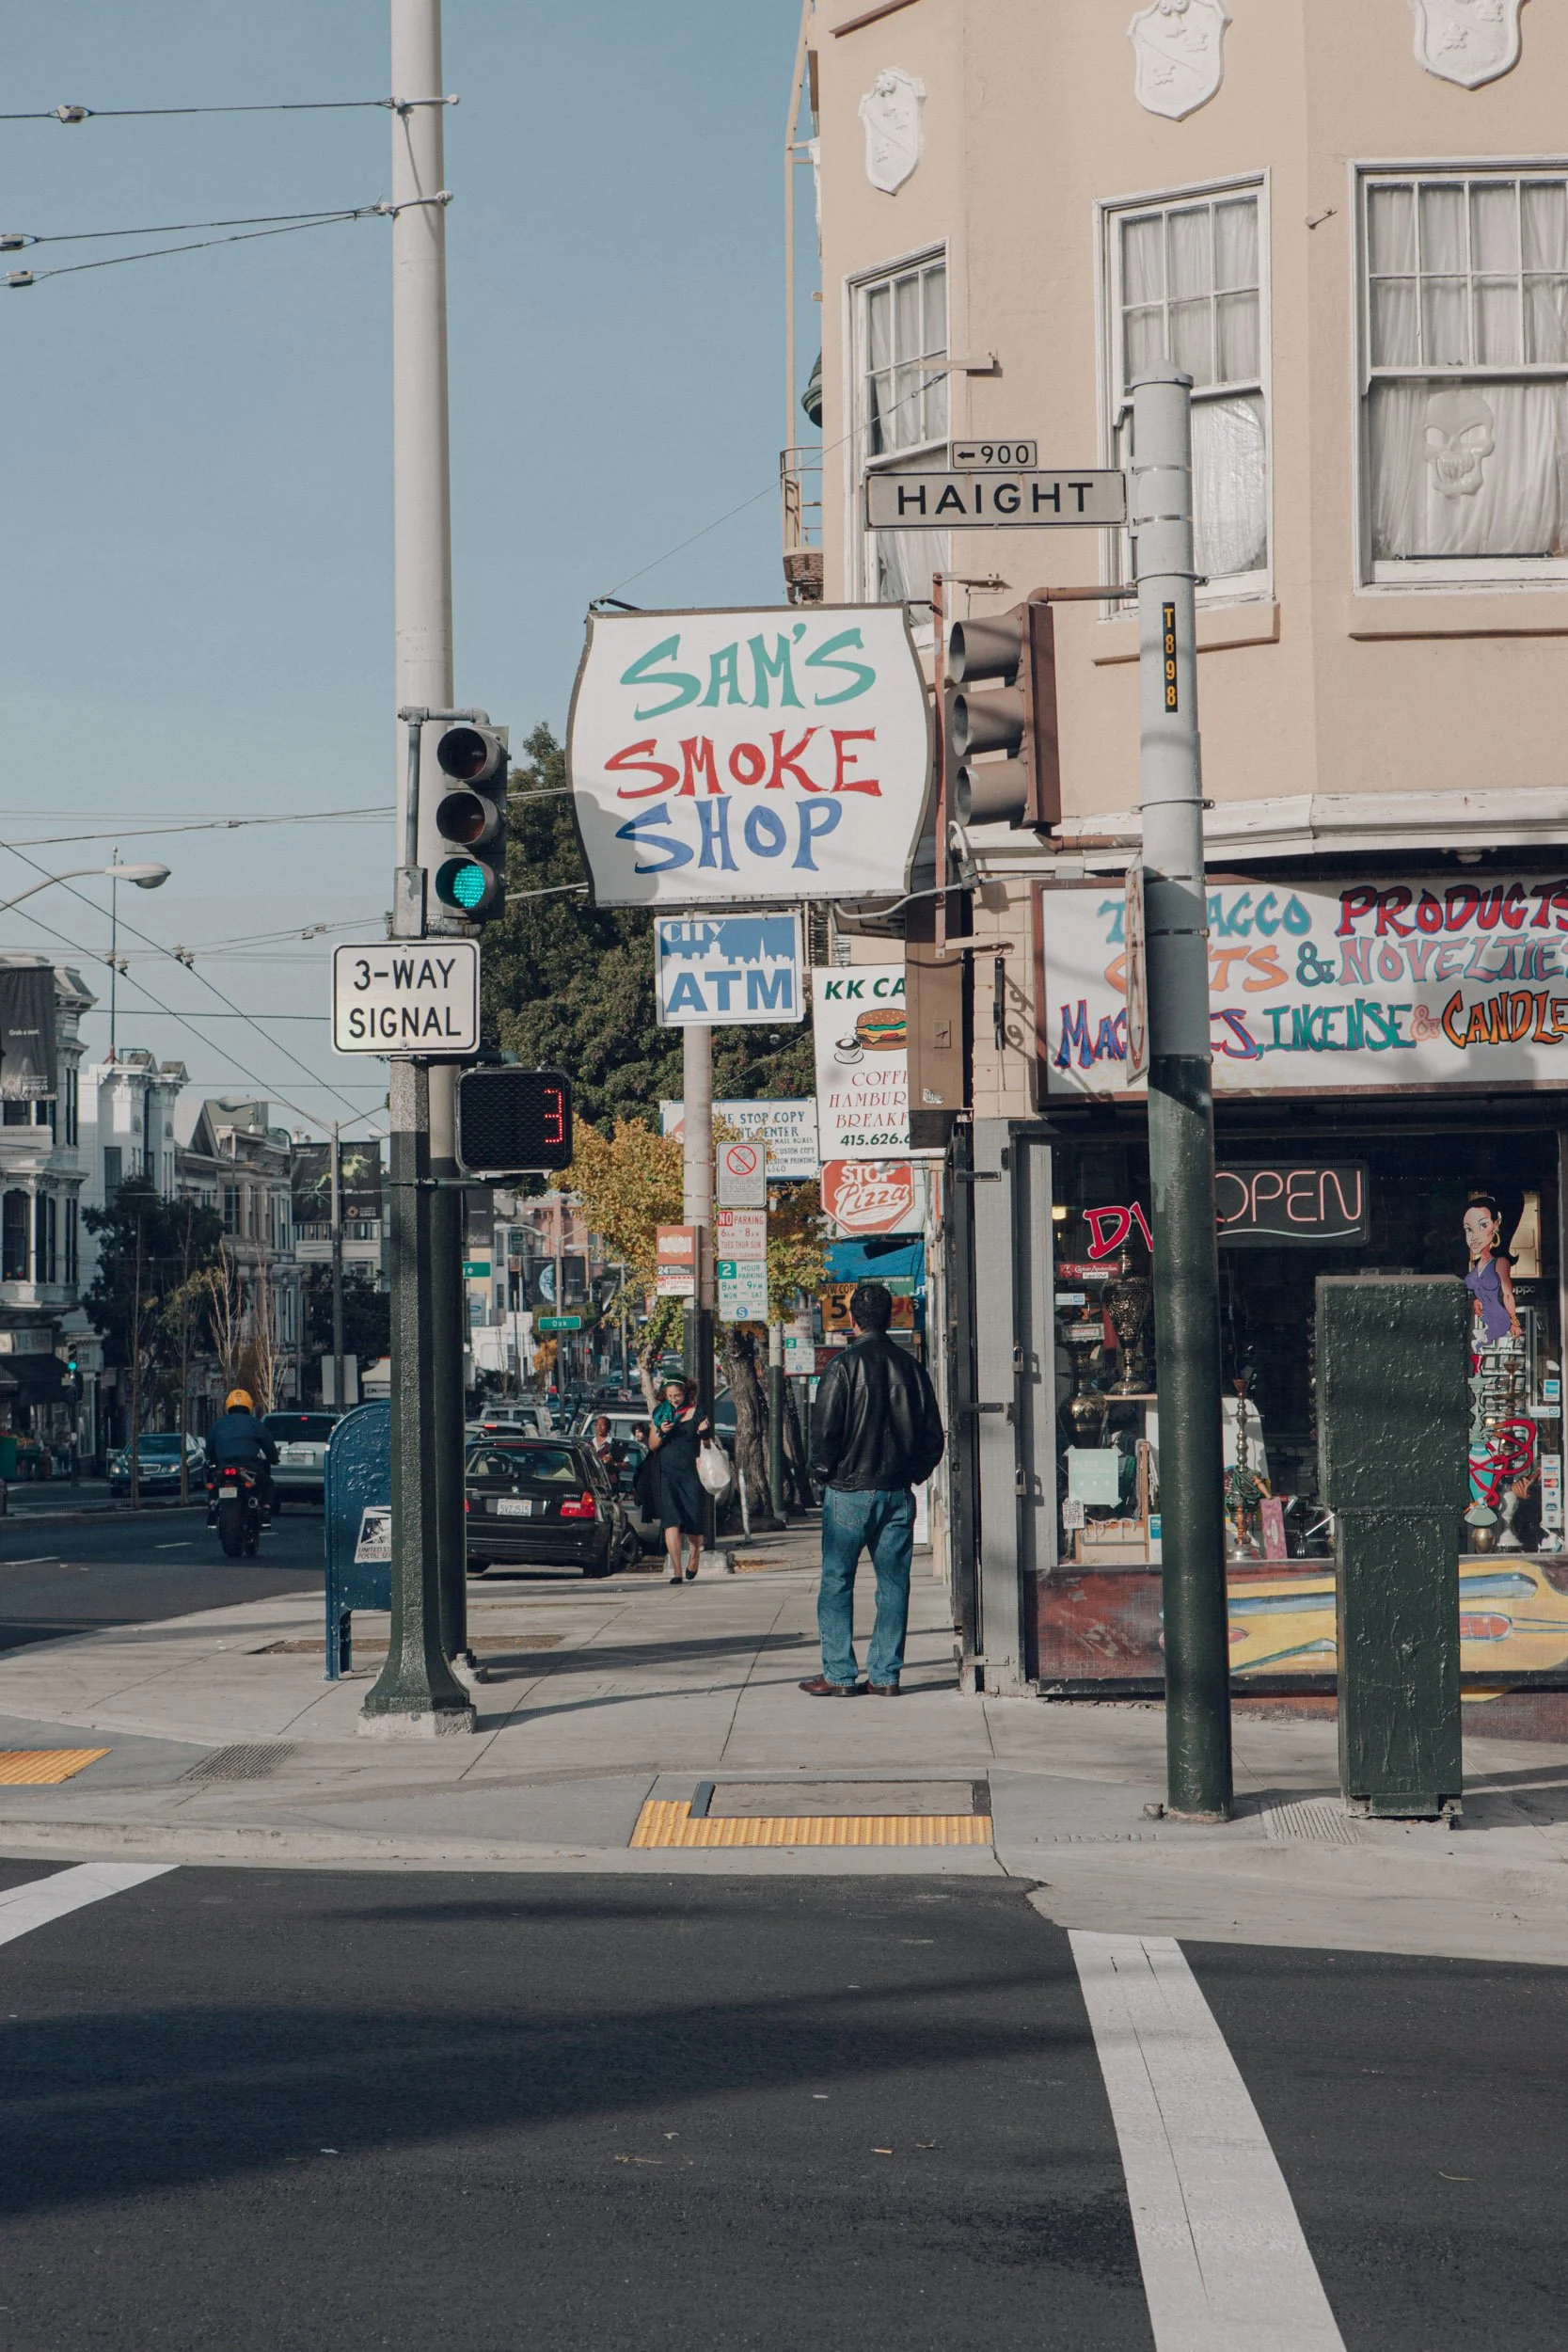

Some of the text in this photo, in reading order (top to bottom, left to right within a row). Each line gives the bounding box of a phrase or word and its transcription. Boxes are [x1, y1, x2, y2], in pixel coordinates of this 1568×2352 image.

[981, 445, 1030, 464] 900
[898, 483, 1093, 516] HAIGHT
[620, 622, 877, 722] SAM'S
[1164, 608, 1178, 706] T898
[604, 725, 882, 799] SMOKE
[615, 796, 843, 874] SHOP
[1335, 879, 1568, 937] PRODUCTS
[662, 922, 726, 942] CITY
[354, 959, 456, 991] 3-WAY
[1296, 941, 1335, 988] &
[666, 969, 793, 1013] ATM
[825, 979, 865, 1000] KK
[349, 1006, 462, 1039] SIGNAL
[544, 1089, 562, 1143] 3
[739, 1112, 768, 1125] STOP
[774, 1111, 805, 1123] COPY
[836, 1183, 908, 1212] Pizza
[1215, 1170, 1361, 1224] OPEN
[719, 1213, 764, 1226] NO PARKING
[657, 1265, 669, 1275] 24
[721, 1263, 732, 1276] 2
[831, 1295, 847, 1319] 5
